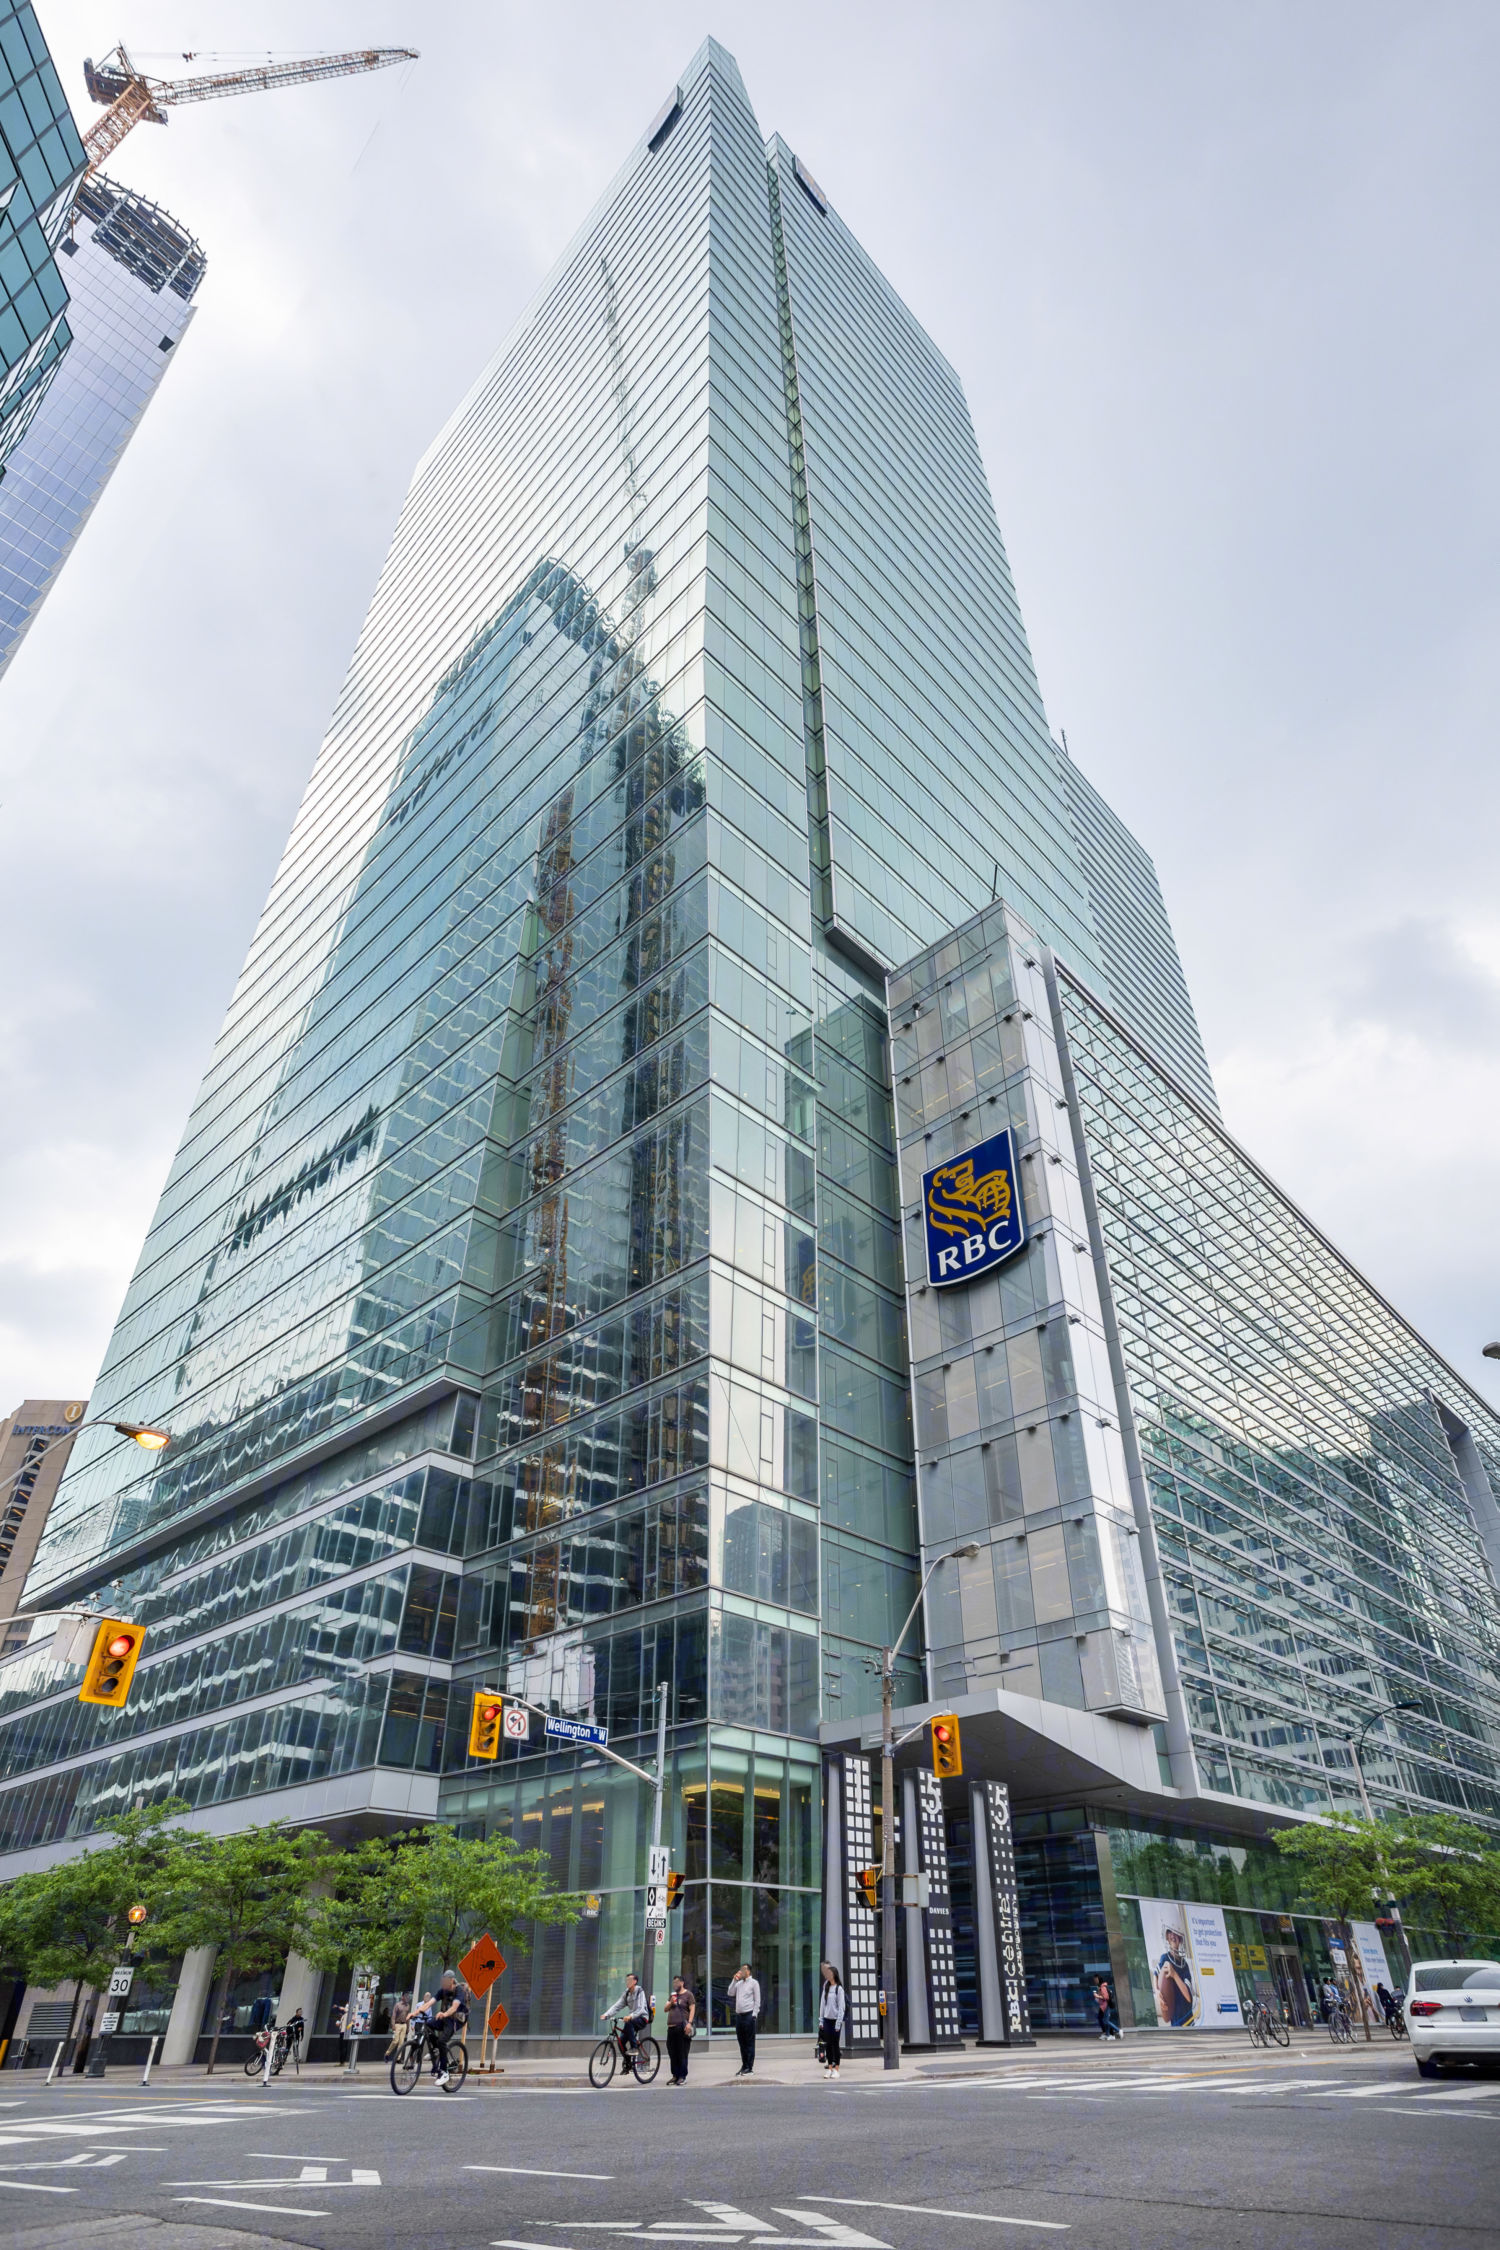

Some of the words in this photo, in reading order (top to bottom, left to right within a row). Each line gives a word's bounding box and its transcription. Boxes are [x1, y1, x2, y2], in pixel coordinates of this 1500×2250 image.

[937, 1220, 1012, 1277] RBC
[548, 1718, 590, 1738] Wellington
[599, 1729, 606, 1741] W
[994, 1785, 1009, 1826] 5
[647, 1919, 665, 1928] BEGINS
[929, 1906, 949, 1915] DAVIES
[1000, 1897, 1016, 1977] centre
[111, 1979, 128, 1991] 30
[1007, 1986, 1022, 2032] RBC
